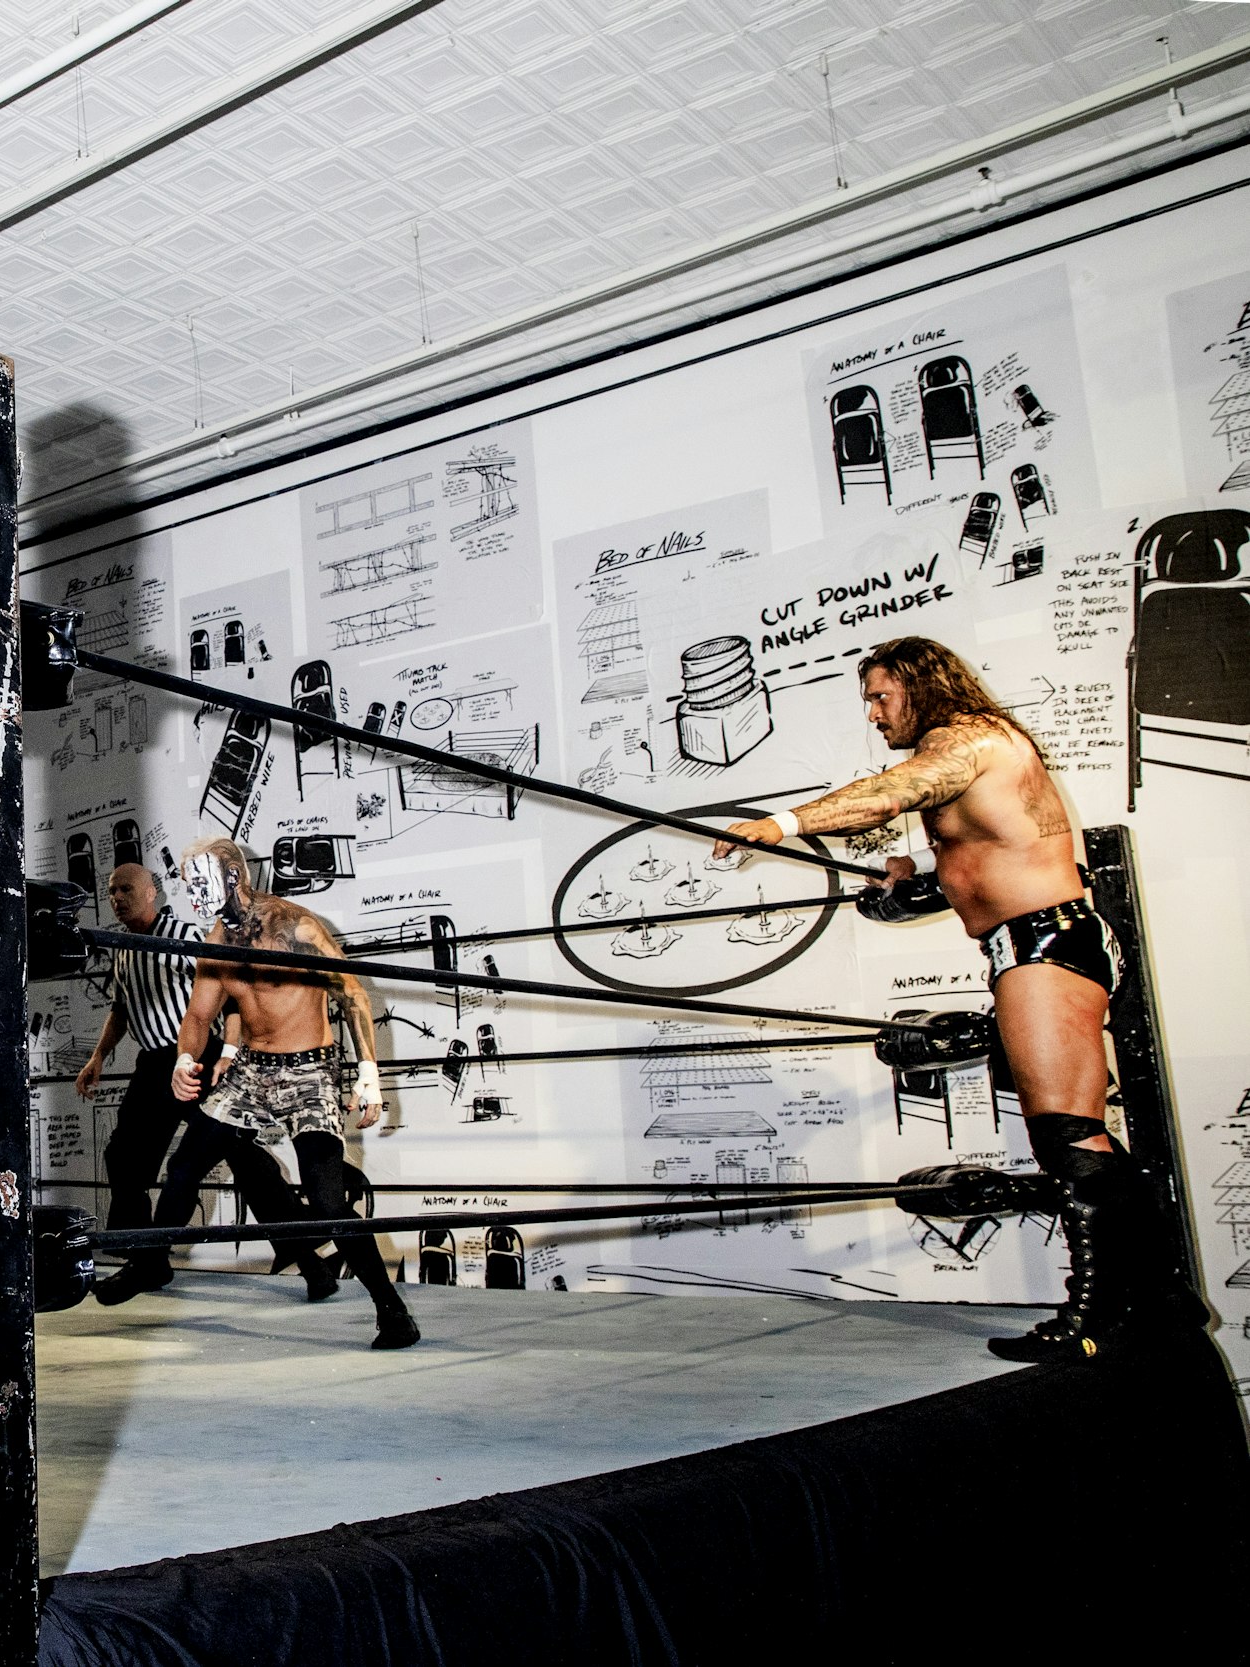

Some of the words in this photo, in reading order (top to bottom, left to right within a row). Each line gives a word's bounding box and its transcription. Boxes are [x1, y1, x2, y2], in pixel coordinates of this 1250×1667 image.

[829, 349, 878, 375] ANATOMY
[897, 340, 905, 350] A
[912, 328, 947, 346] CHAIR
[894, 493, 943, 515] DIFFERENT
[595, 549, 628, 573] BED
[636, 544, 653, 559] OF
[656, 531, 705, 556] NAILS
[1074, 554, 1100, 565] PUSH
[1105, 551, 1121, 562] IN
[1061, 569, 1091, 579] BACK
[1098, 567, 1123, 576] REST
[66, 578, 87, 597] BED
[91, 574, 105, 585] OF
[104, 564, 134, 585] NAILS
[1057, 583, 1072, 592] ON
[1079, 581, 1103, 590] SEAT
[761, 598, 803, 626] CUT
[817, 572, 891, 607] DOWN
[905, 553, 939, 582] W/
[1048, 598, 1075, 608] THIS
[1081, 594, 1118, 606] AVOIDS
[761, 617, 828, 653] ANGLE
[840, 584, 953, 626] GRINDER
[1054, 609, 1075, 619] ANY
[1081, 605, 1129, 617] UNWANTED
[1078, 620, 1090, 628] OR
[1057, 629, 1100, 642] DAMAGE
[1057, 642, 1093, 654] SKULL
[392, 667, 424, 682] THUMB
[426, 662, 449, 674] TACK
[412, 674, 438, 686] MATCH
[1059, 685, 1067, 694] 3
[338, 687, 350, 714] USED
[1052, 697, 1068, 707] IN
[1054, 704, 1113, 717] PLACEMENT
[1039, 730, 1070, 739] THESE
[1080, 727, 1113, 736] RIVETS
[1042, 742, 1060, 750] CAN
[1068, 740, 1081, 748] BE
[1087, 740, 1126, 748] REMOVED
[1054, 751, 1091, 760] CREATE
[1045, 763, 1069, 771] RIOUS
[1077, 762, 1112, 771] EFFECTS
[240, 790, 262, 843] BARBED
[261, 751, 276, 786] WIRE
[67, 807, 92, 821] ANATOMY
[109, 798, 127, 808] CHAIR
[277, 819, 294, 829] PILES
[306, 816, 328, 825] CHAIRS
[361, 894, 394, 907] ANATOMY
[418, 889, 442, 899] CHAIR
[892, 975, 943, 989] ANATOMY
[965, 974, 972, 982] A
[358, 1101, 389, 1112] WE
[956, 1151, 1007, 1163] DIFFERENT
[1010, 1158, 1035, 1166] CHAIRS
[422, 1196, 457, 1207] ANATOMY
[483, 1195, 508, 1207] CHAIR
[933, 1264, 958, 1272] BREAK
